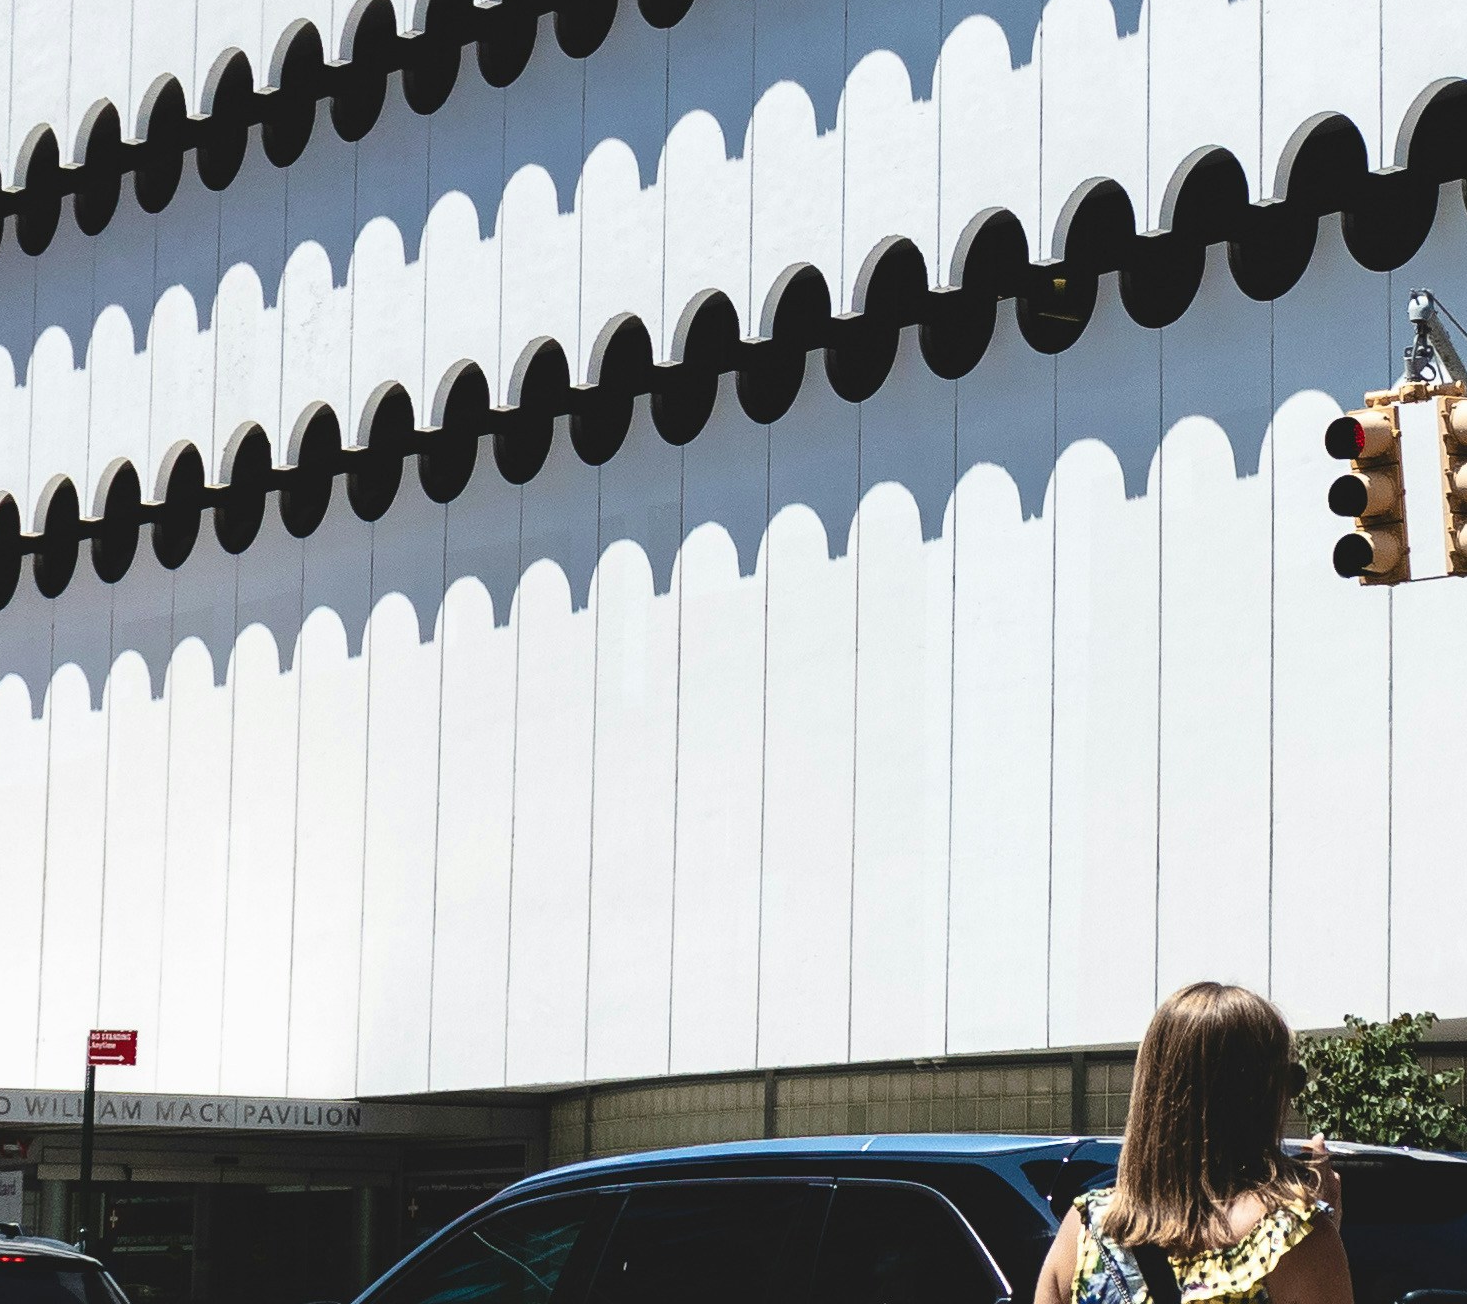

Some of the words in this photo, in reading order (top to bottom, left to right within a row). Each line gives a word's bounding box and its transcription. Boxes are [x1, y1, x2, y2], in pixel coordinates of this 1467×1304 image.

[24, 1095, 142, 1120] WILLAM
[155, 1100, 231, 1123] MACK
[243, 1103, 362, 1127] PAVILION
